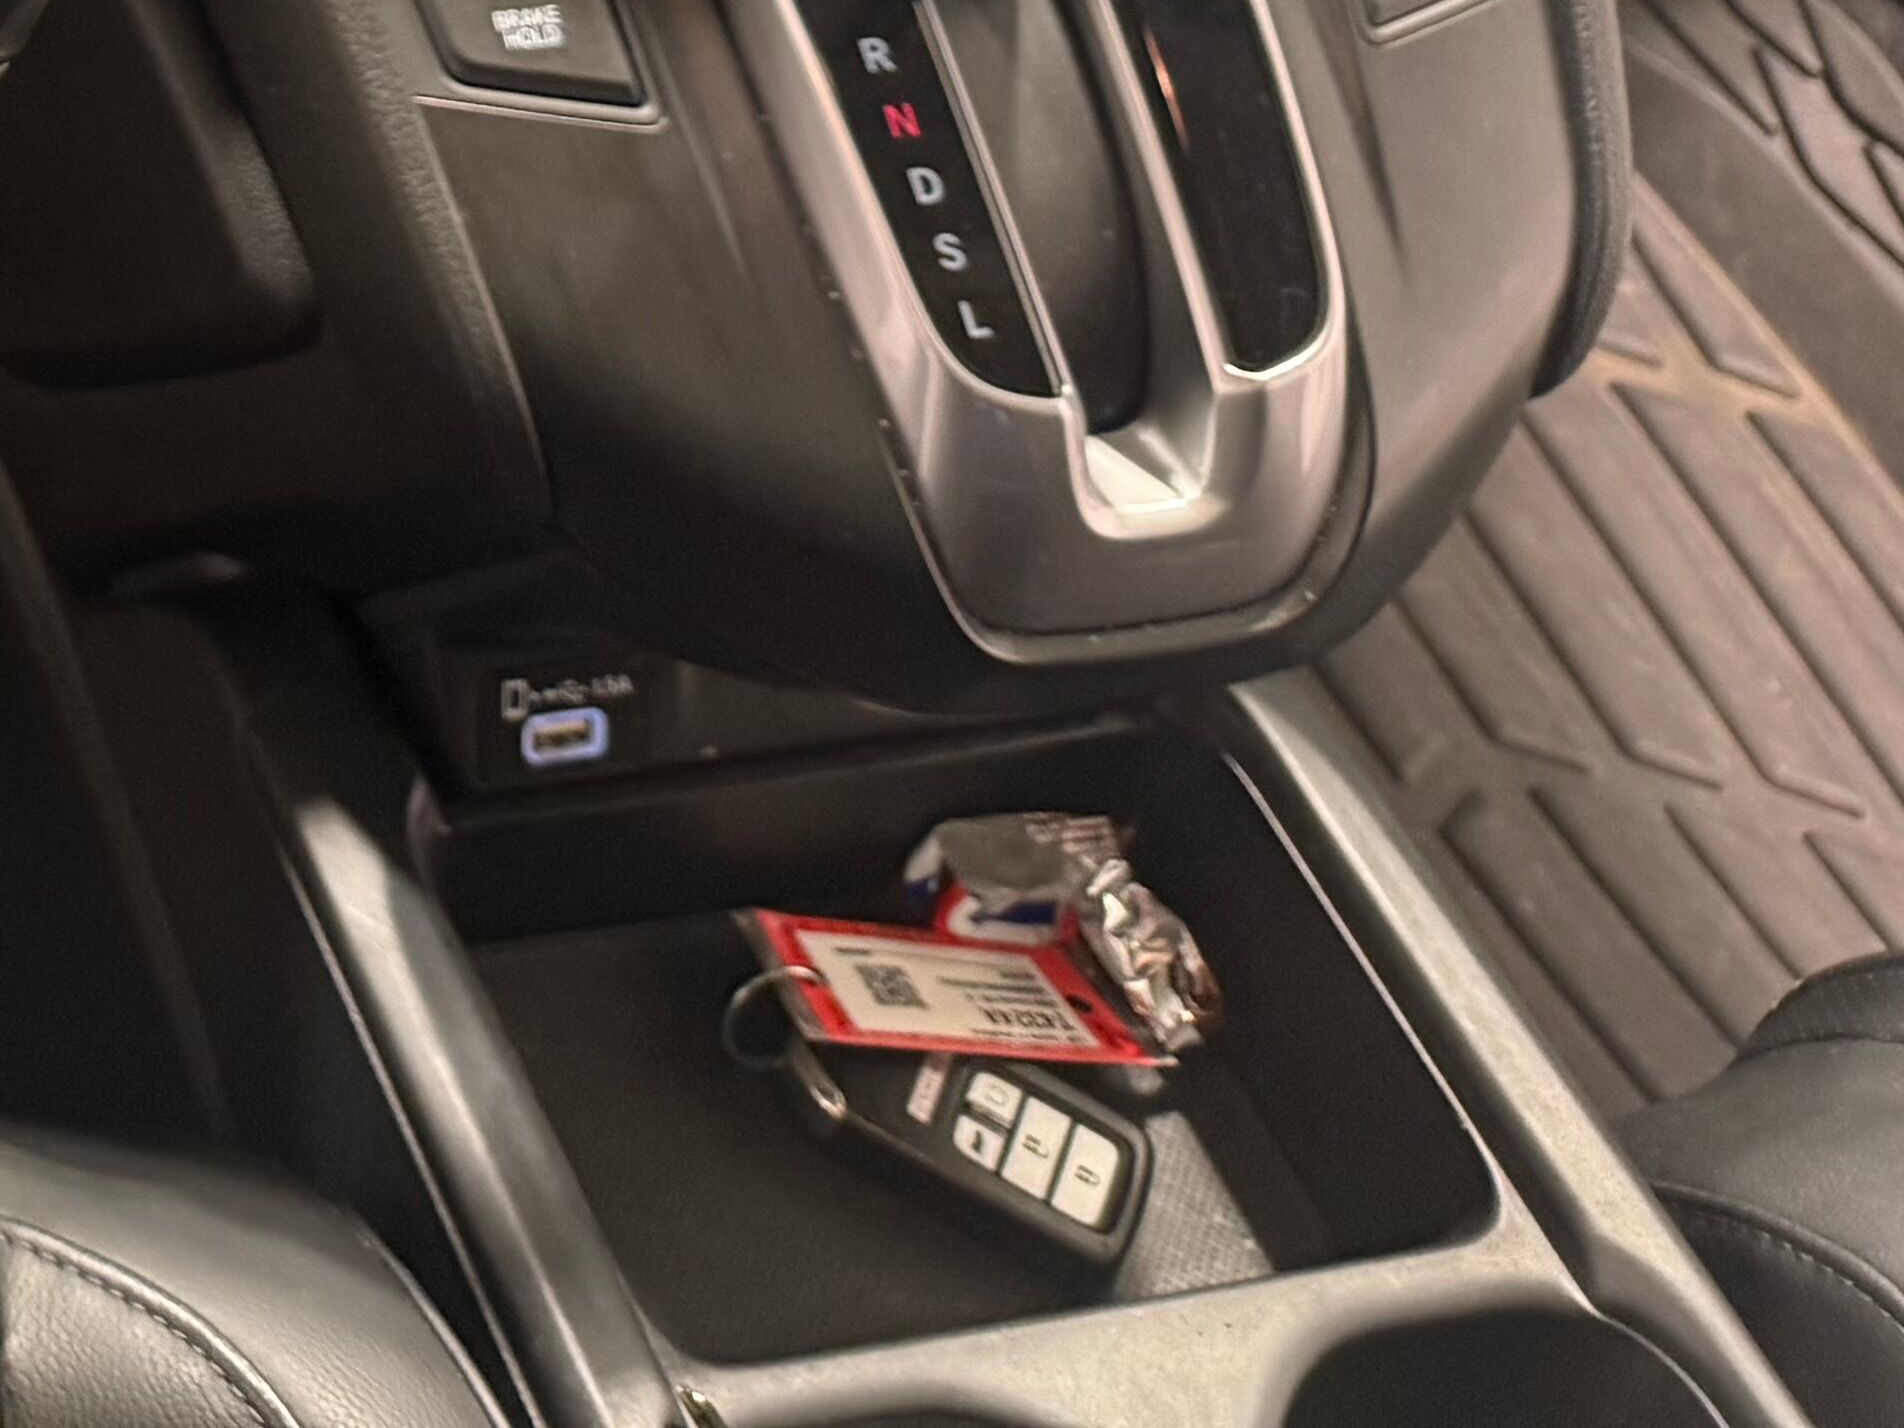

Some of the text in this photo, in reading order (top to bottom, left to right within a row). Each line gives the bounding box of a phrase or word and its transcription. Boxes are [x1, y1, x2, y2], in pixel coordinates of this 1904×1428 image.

[491, 3, 562, 33] BRAKE
[857, 36, 898, 74] R
[882, 102, 922, 138] N
[906, 166, 945, 206] D
[932, 233, 968, 272] S
[958, 300, 993, 340] L
